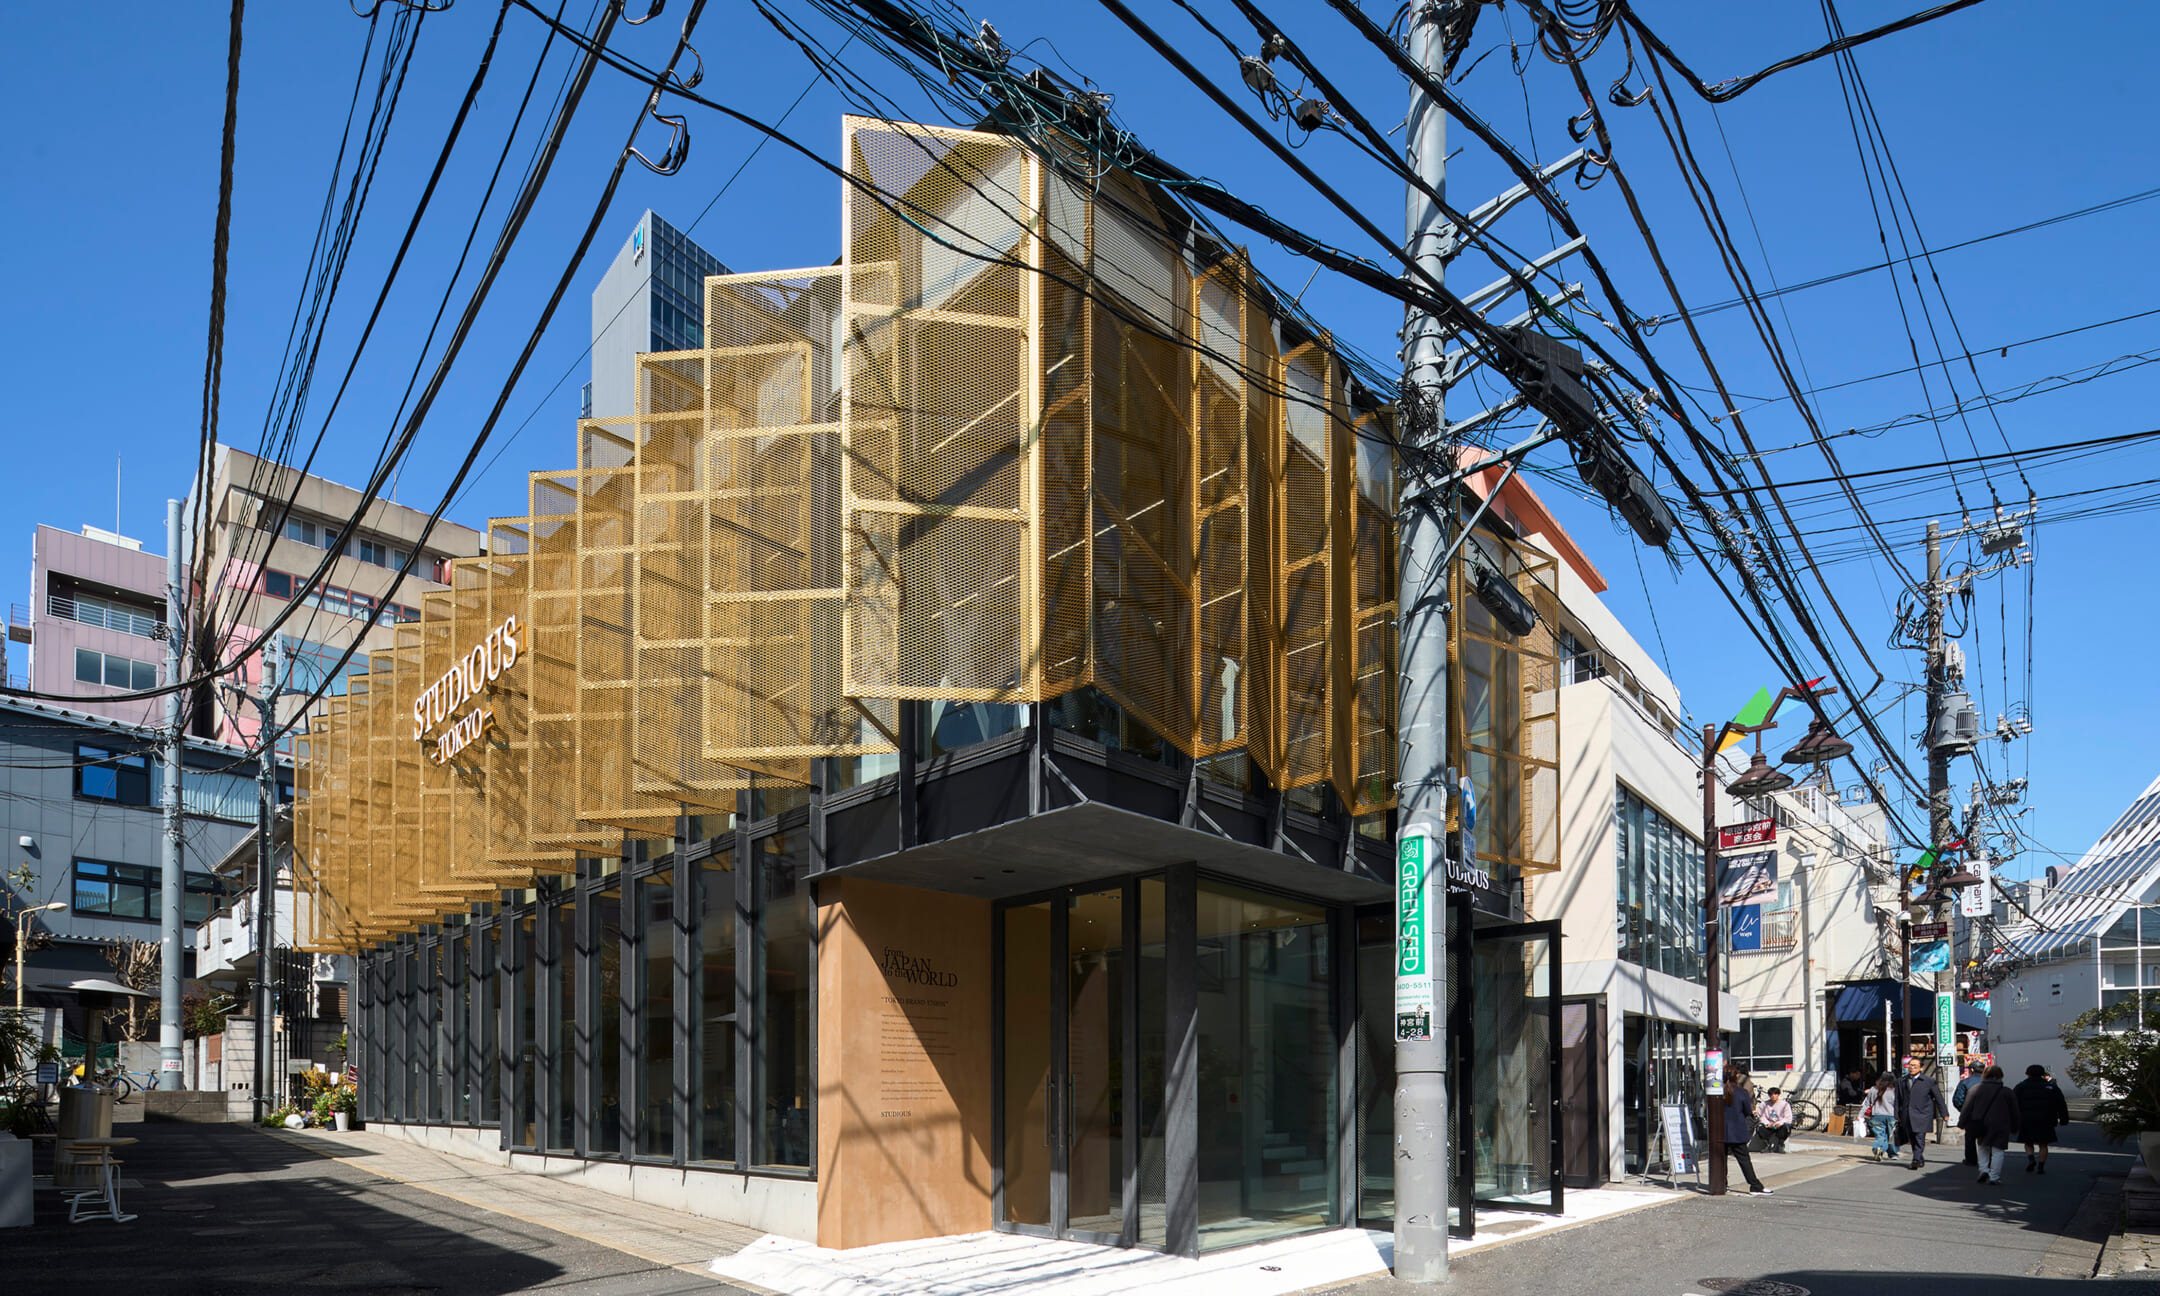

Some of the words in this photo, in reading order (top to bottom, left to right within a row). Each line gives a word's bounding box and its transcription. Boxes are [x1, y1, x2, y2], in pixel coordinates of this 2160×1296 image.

[414, 614, 517, 741] STUDIOUS
[1402, 861, 1418, 922] GREEN
[1402, 924, 1419, 972] SEED
[881, 954, 932, 973] JAPAN
[905, 969, 958, 987] WORLD
[1400, 1018, 1425, 1027] 神宮前
[1400, 1027, 1424, 1036] 4-28
[881, 1110, 912, 1118] STUDIOUS
